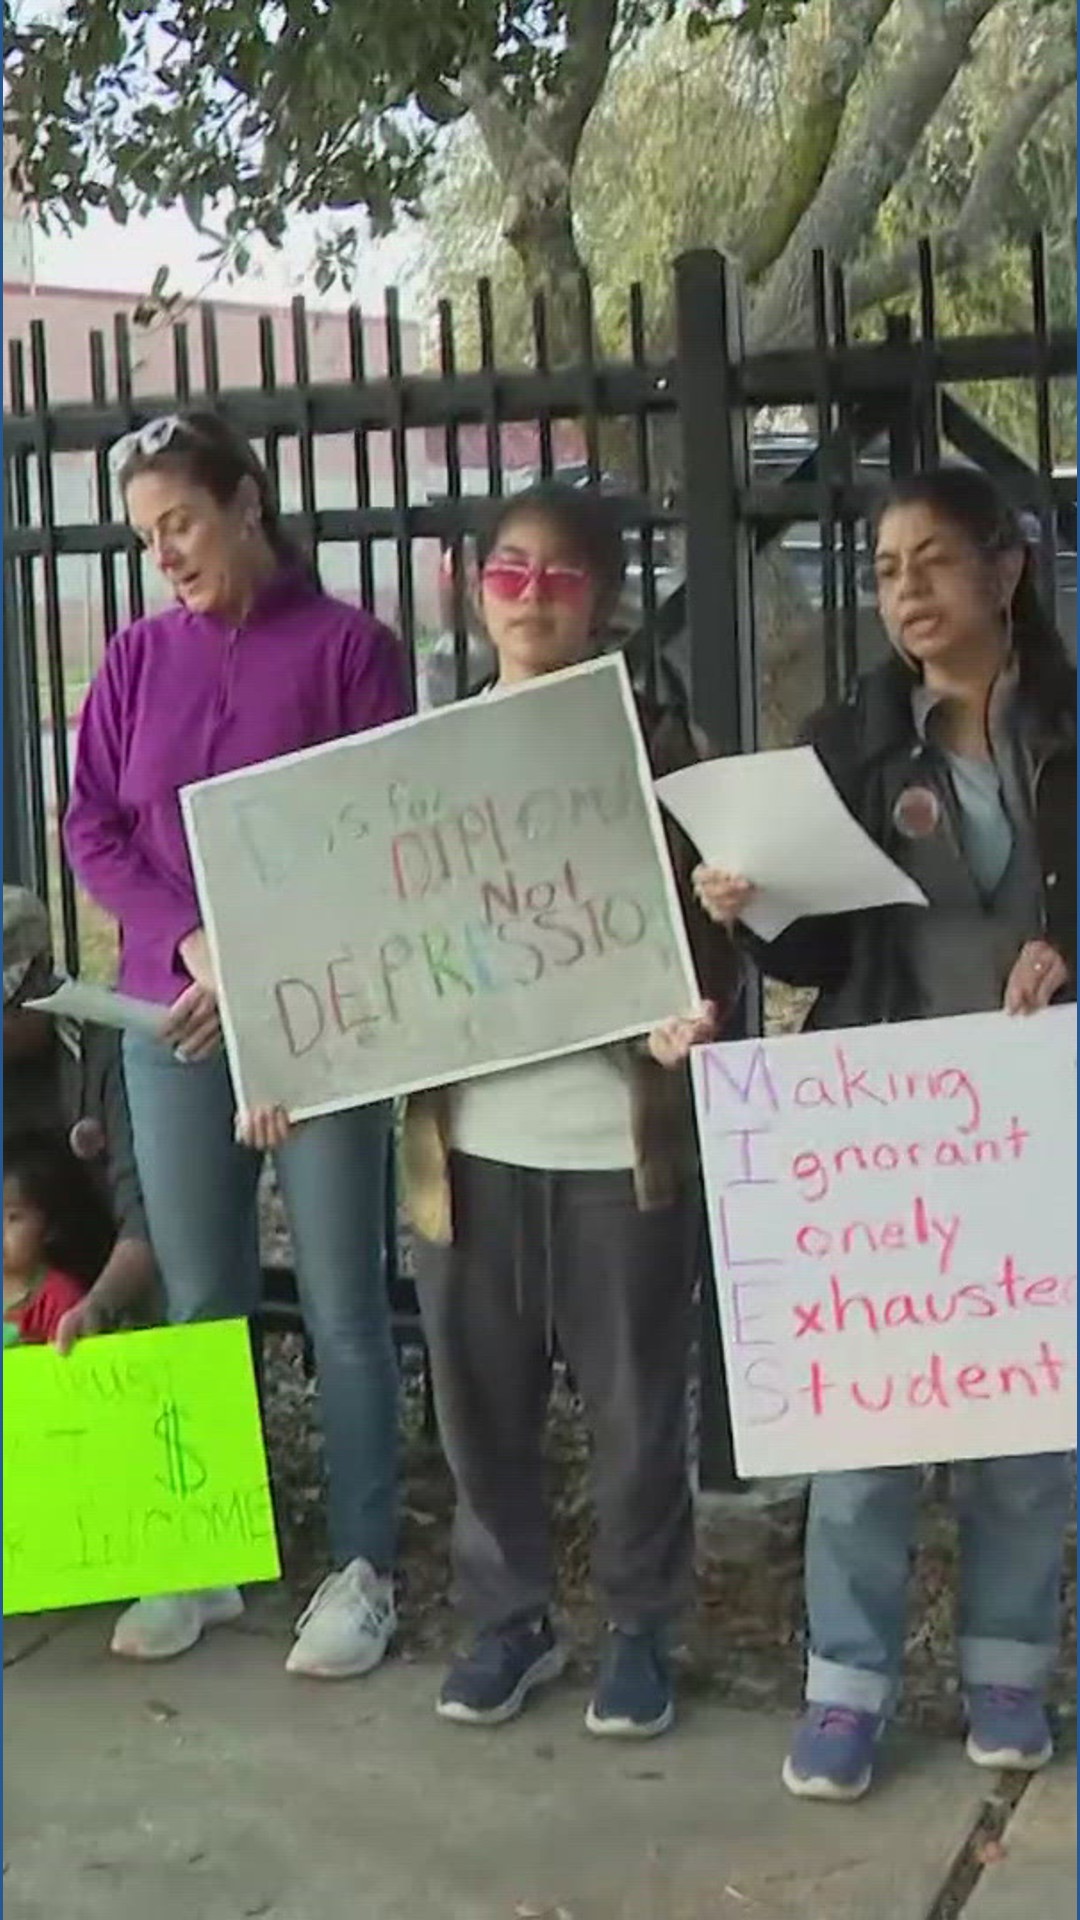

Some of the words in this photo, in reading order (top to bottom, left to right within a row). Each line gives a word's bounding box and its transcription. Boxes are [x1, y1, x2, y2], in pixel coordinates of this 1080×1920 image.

[273, 893, 671, 1059] DEPRESSIO
[702, 1042, 982, 1135] Making
[724, 1115, 1030, 1202] Ignorant
[719, 1196, 961, 1275] Lonely
[743, 1340, 1064, 1427] Student
